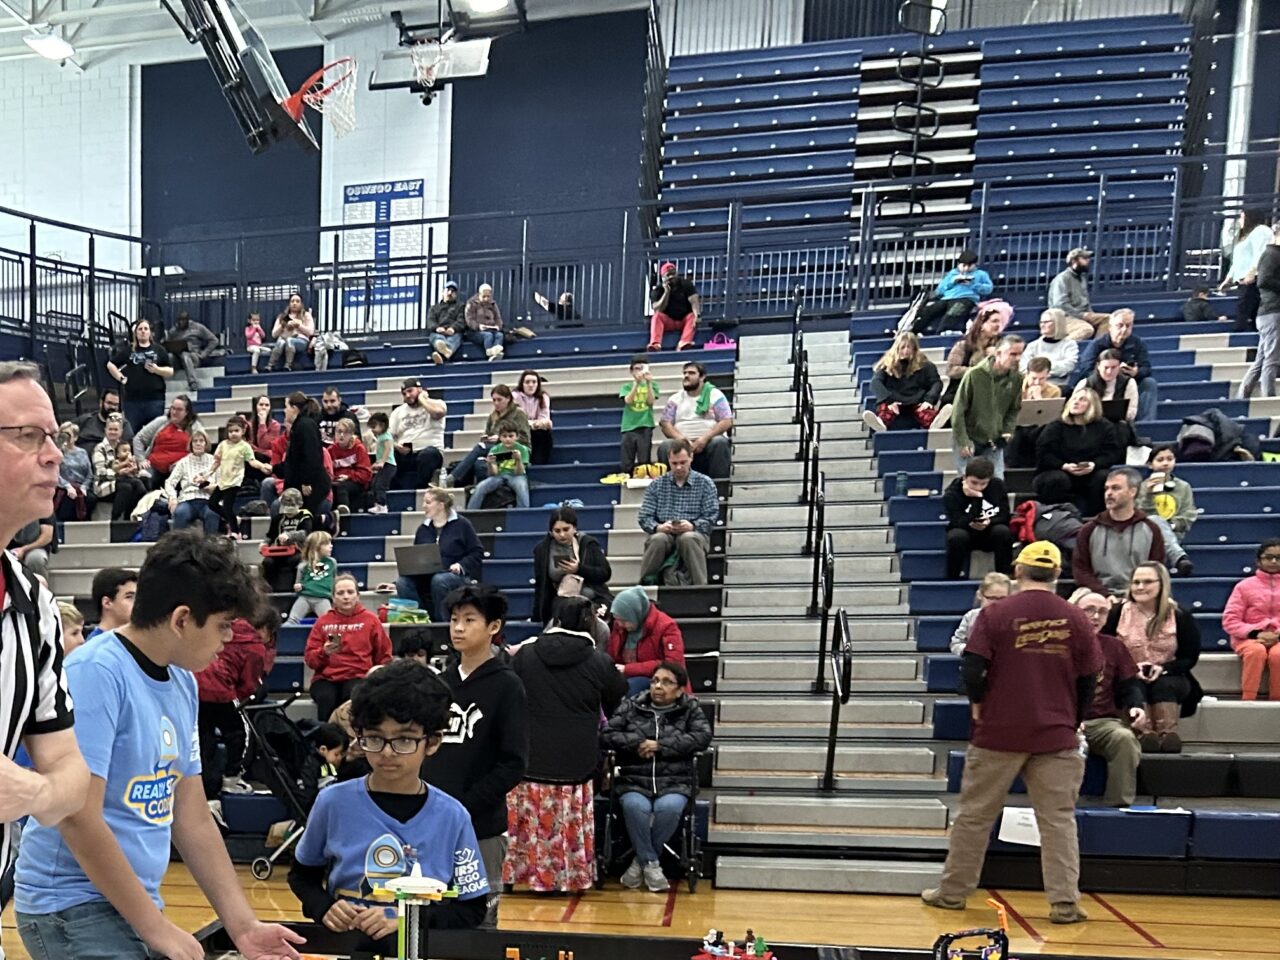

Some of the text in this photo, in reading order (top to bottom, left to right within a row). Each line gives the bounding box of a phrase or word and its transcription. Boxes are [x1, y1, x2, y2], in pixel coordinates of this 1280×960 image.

[346, 180, 422, 196] OSWEGO EAST
[453, 871, 480, 886] LEGO
[457, 877, 489, 894] EAGUE
